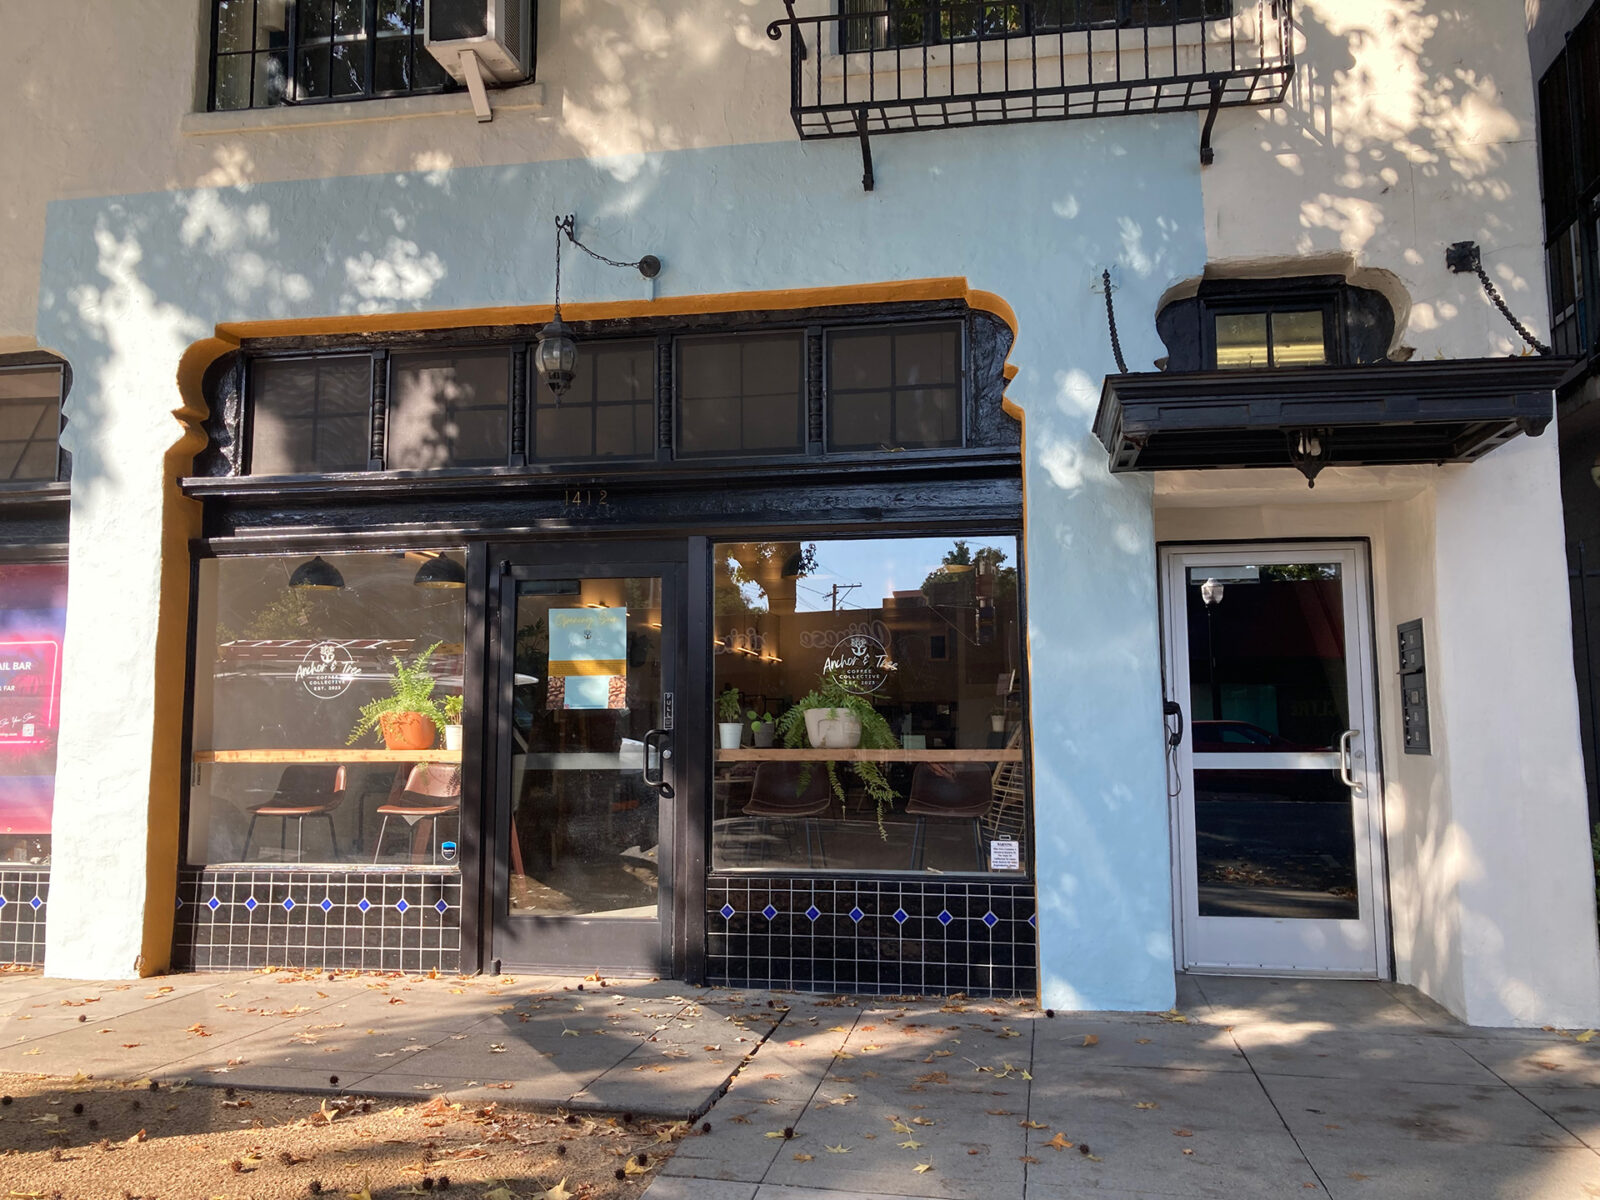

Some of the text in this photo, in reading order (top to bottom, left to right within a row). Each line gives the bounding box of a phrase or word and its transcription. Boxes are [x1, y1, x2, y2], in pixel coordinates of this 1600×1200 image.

[565, 489, 607, 506] 1412
[13, 661, 32, 670] BAR
[295, 661, 327, 682] Anchor
[341, 661, 362, 675] Tree
[823, 654, 859, 676] Anchor
